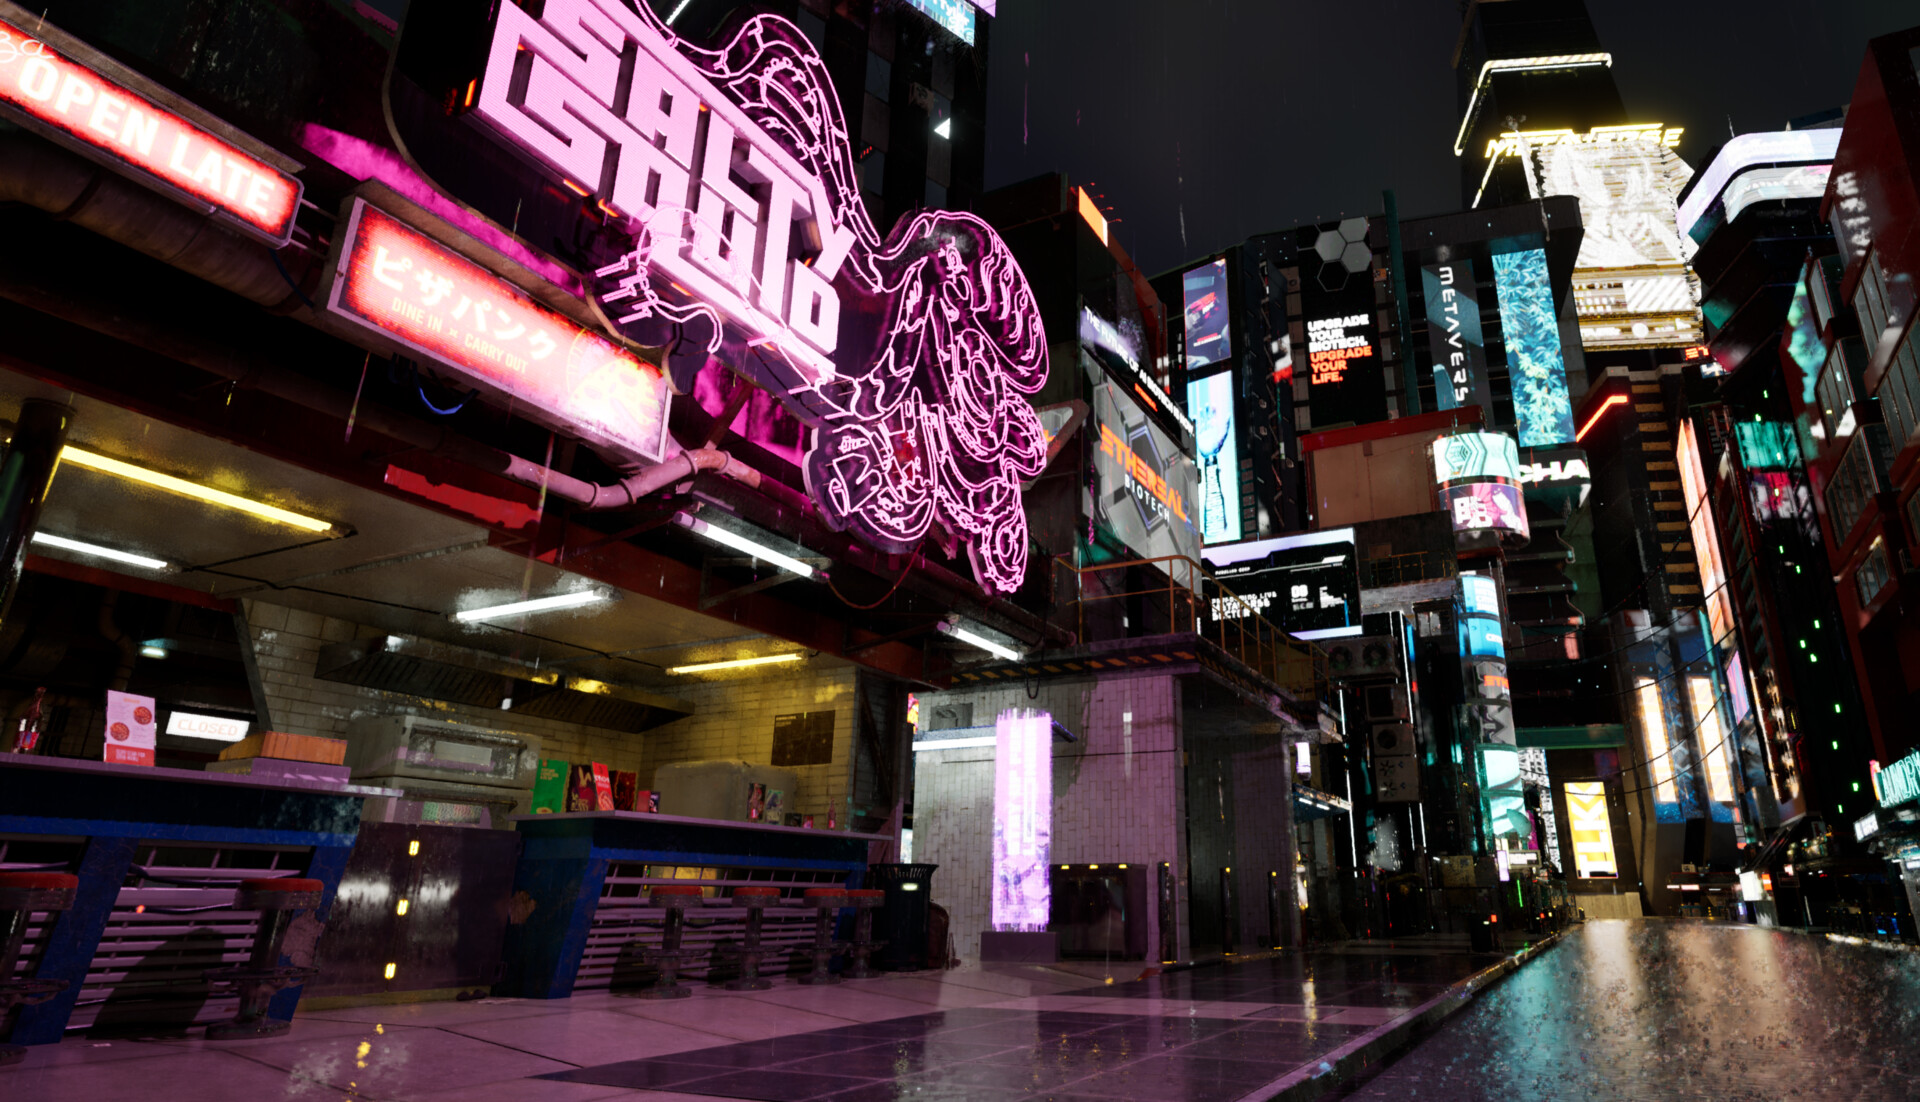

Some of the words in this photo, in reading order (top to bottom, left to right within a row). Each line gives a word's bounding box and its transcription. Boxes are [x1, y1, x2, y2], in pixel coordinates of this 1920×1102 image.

[18, 57, 160, 157] OPEN
[167, 131, 276, 217] LATE
[372, 245, 558, 361] ピザパンク
[392, 297, 425, 326] DINE
[427, 310, 442, 333] IN
[464, 334, 505, 363] CARRY
[504, 350, 528, 374] OUT
[1085, 305, 1101, 332] THE
[1101, 327, 1129, 365] FUTURE
[1129, 357, 1140, 373] OF
[1307, 313, 1370, 332] UPGRADE
[1308, 328, 1345, 342] YOUR
[1439, 266, 1469, 406] METAVERS
[1308, 335, 1368, 353] BIOTECH.
[1310, 345, 1372, 363] UPGRADE
[1311, 359, 1348, 374] YOUR
[1312, 371, 1344, 385] LIFE.
[1100, 423, 1187, 522] ETHEREAL
[1124, 473, 1170, 523] BIOTECH
[177, 718, 238, 737] CLOSED
